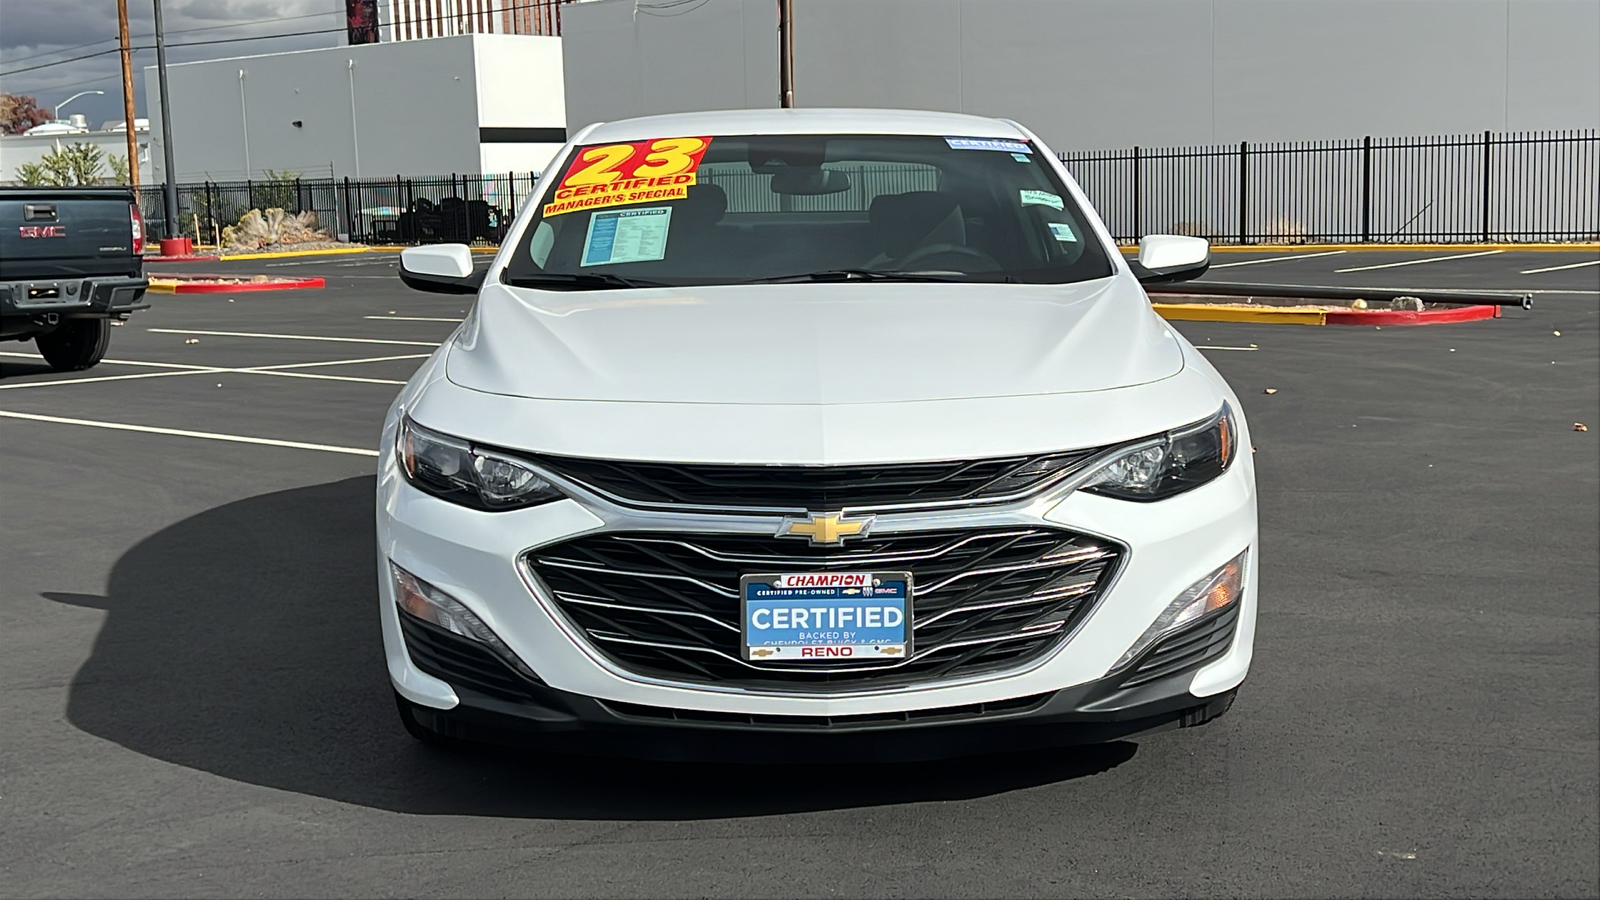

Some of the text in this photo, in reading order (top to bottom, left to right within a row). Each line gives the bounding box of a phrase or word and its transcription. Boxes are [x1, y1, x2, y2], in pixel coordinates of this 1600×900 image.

[951, 140, 1025, 149] CERTIFIED
[564, 138, 707, 186] 23
[557, 174, 692, 199] CERTIFIED
[545, 188, 683, 214] MANAGER'S SPECIAL
[20, 226, 66, 238] GMC
[787, 575, 865, 586] CHAMPION
[752, 607, 903, 629] CERTIFIED
[799, 631, 857, 640] BACKED BY
[801, 647, 853, 657] RENO
